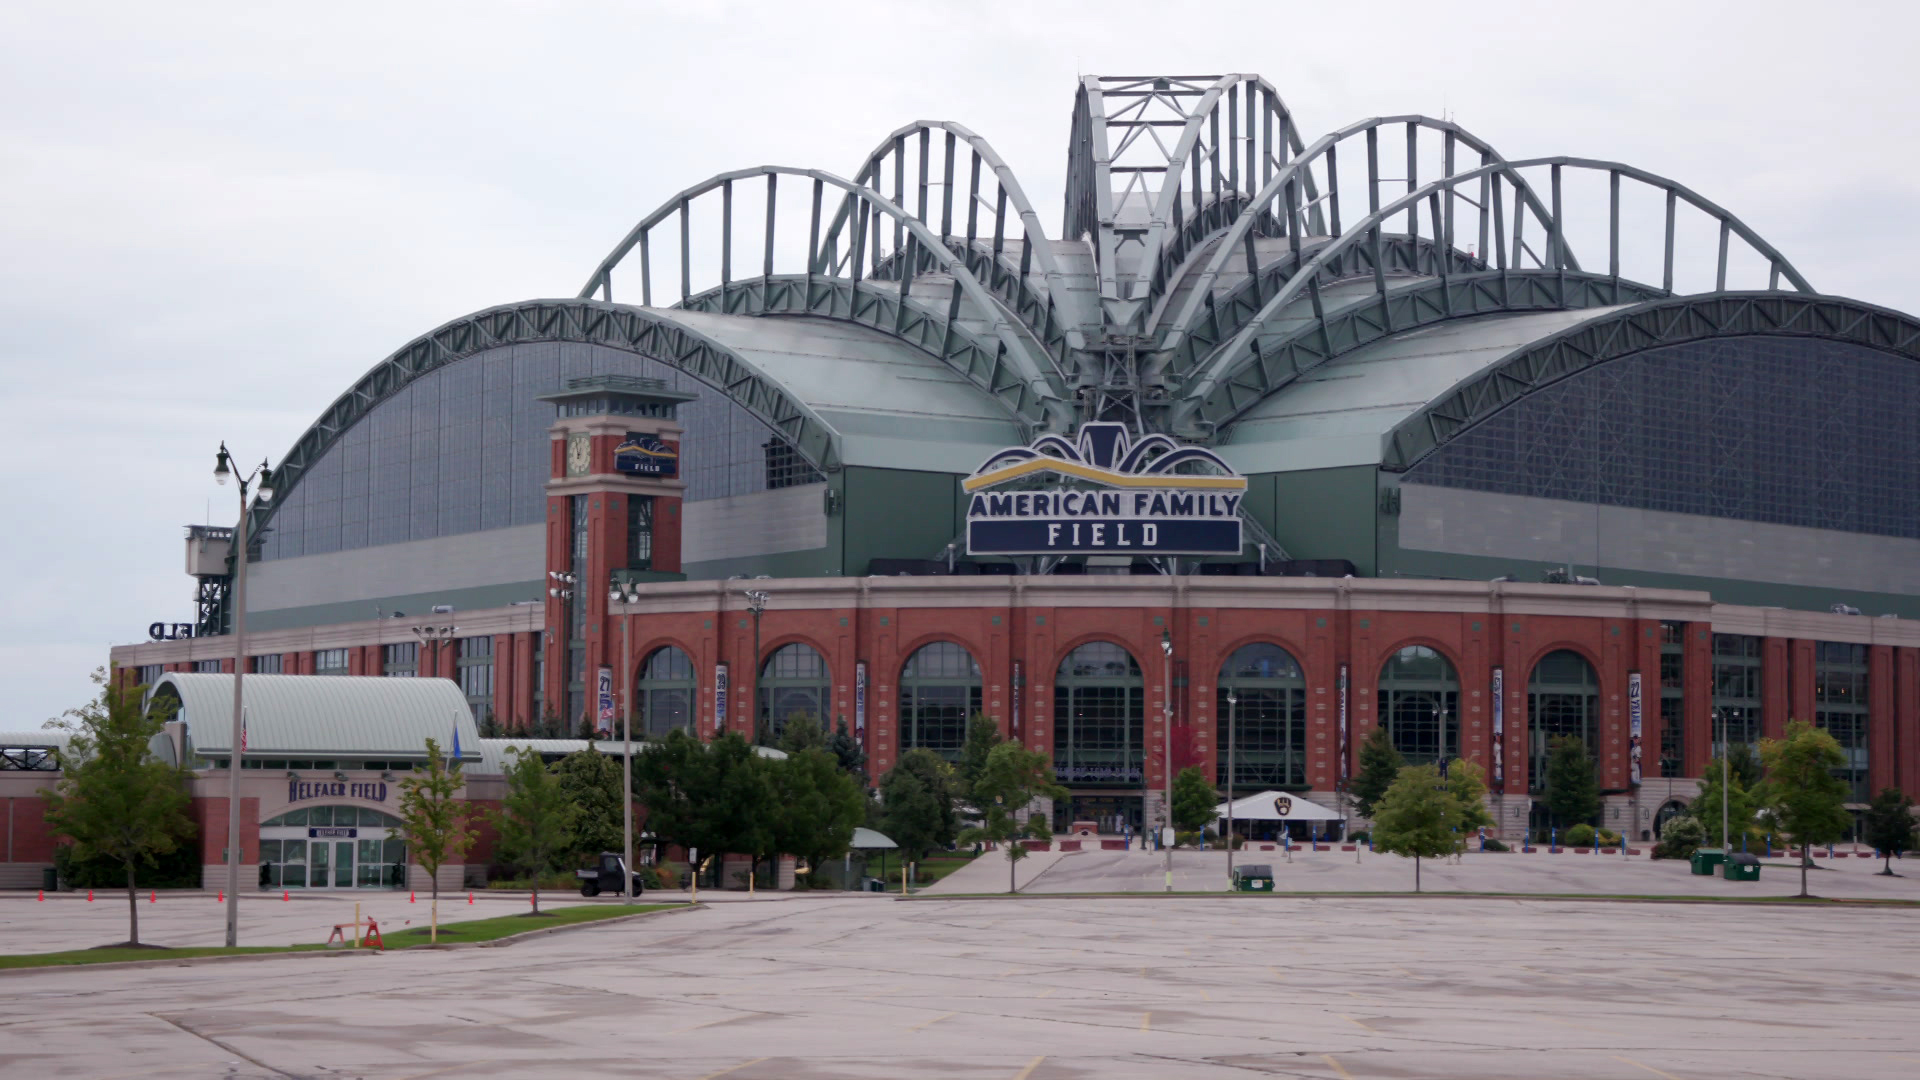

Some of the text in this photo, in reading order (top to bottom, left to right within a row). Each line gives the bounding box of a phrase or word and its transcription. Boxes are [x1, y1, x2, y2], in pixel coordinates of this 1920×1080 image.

[635, 464, 660, 472] FIELD
[970, 493, 1239, 516] AMERICAN FAMILY
[1048, 523, 1158, 546] FIELD
[288, 781, 387, 803] HELFAER FIELD
